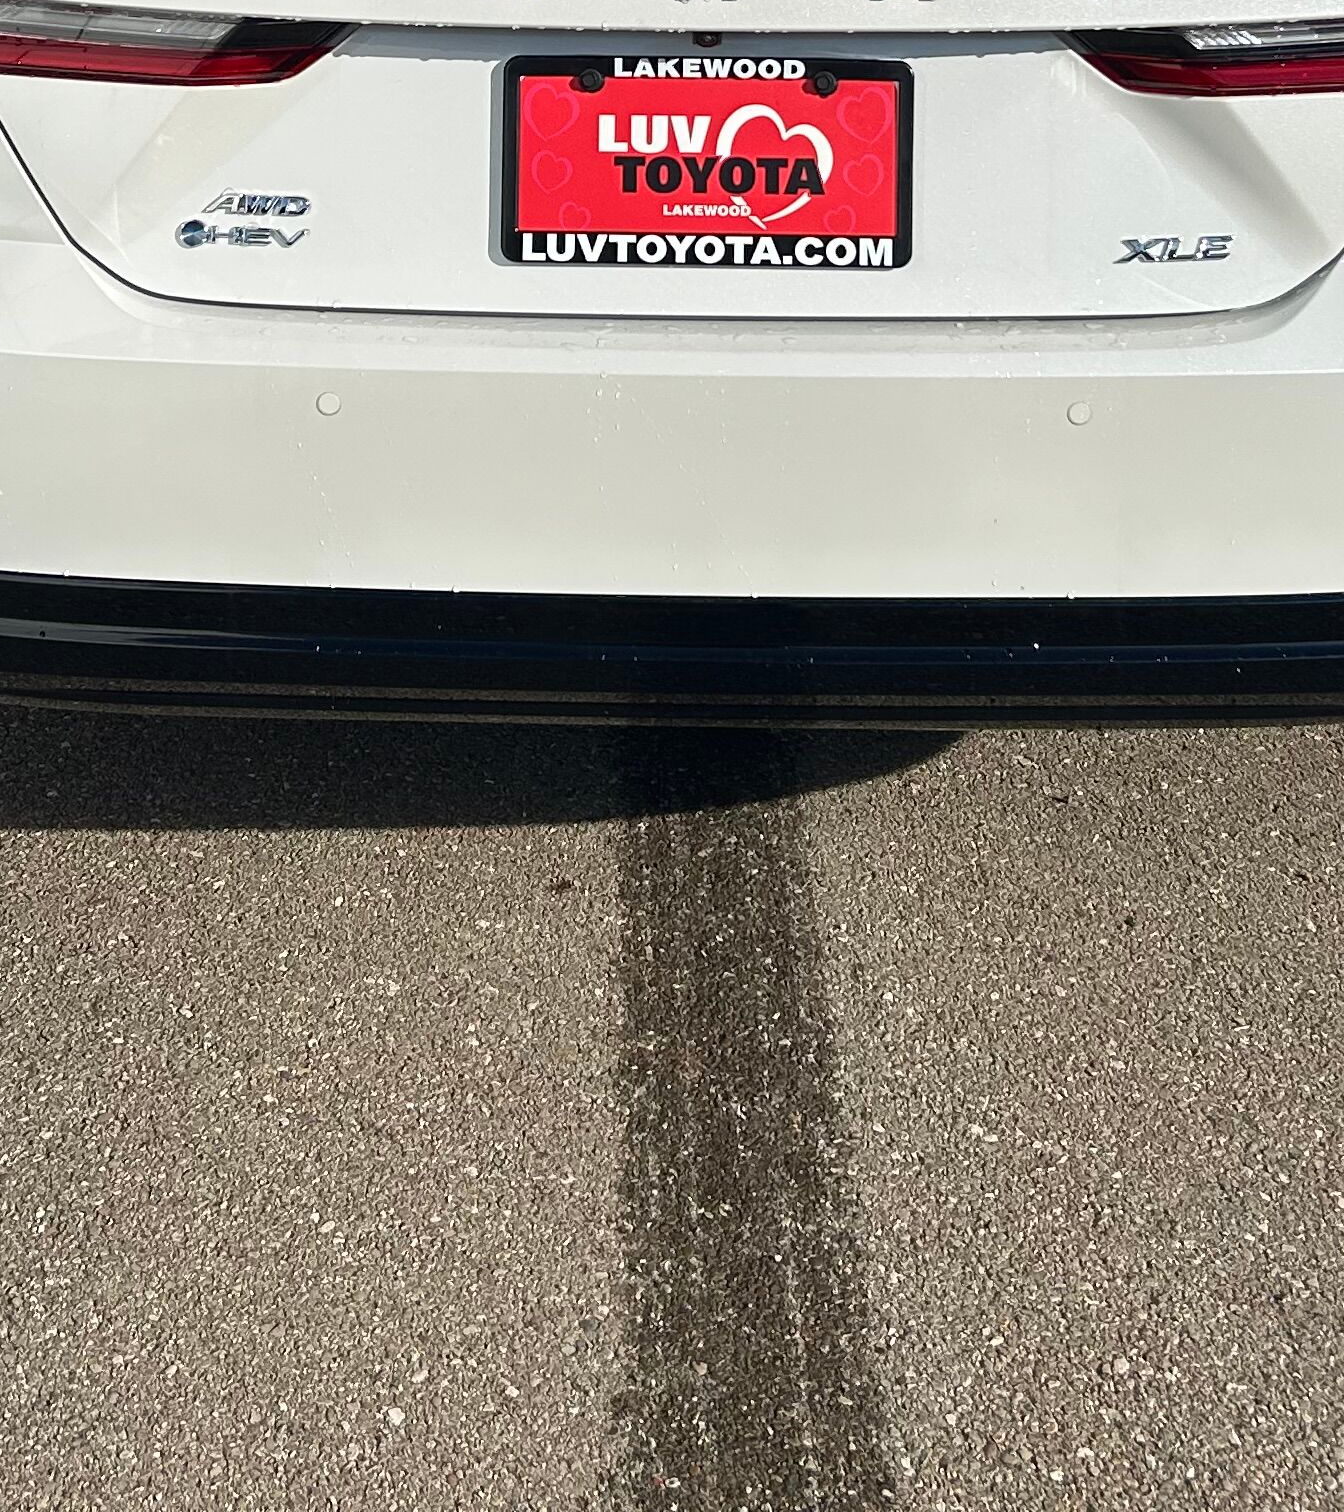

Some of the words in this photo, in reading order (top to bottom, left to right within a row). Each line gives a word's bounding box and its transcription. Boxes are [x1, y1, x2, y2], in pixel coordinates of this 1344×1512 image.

[614, 57, 806, 79] LAKEWOOD
[598, 115, 711, 153] LUV
[614, 156, 825, 195] TOYOTA
[201, 187, 312, 217] AWD
[662, 204, 752, 218] LAKEWOOD
[521, 232, 894, 267] LUVTOYOTA.COM
[1112, 235, 1236, 264] XLE
